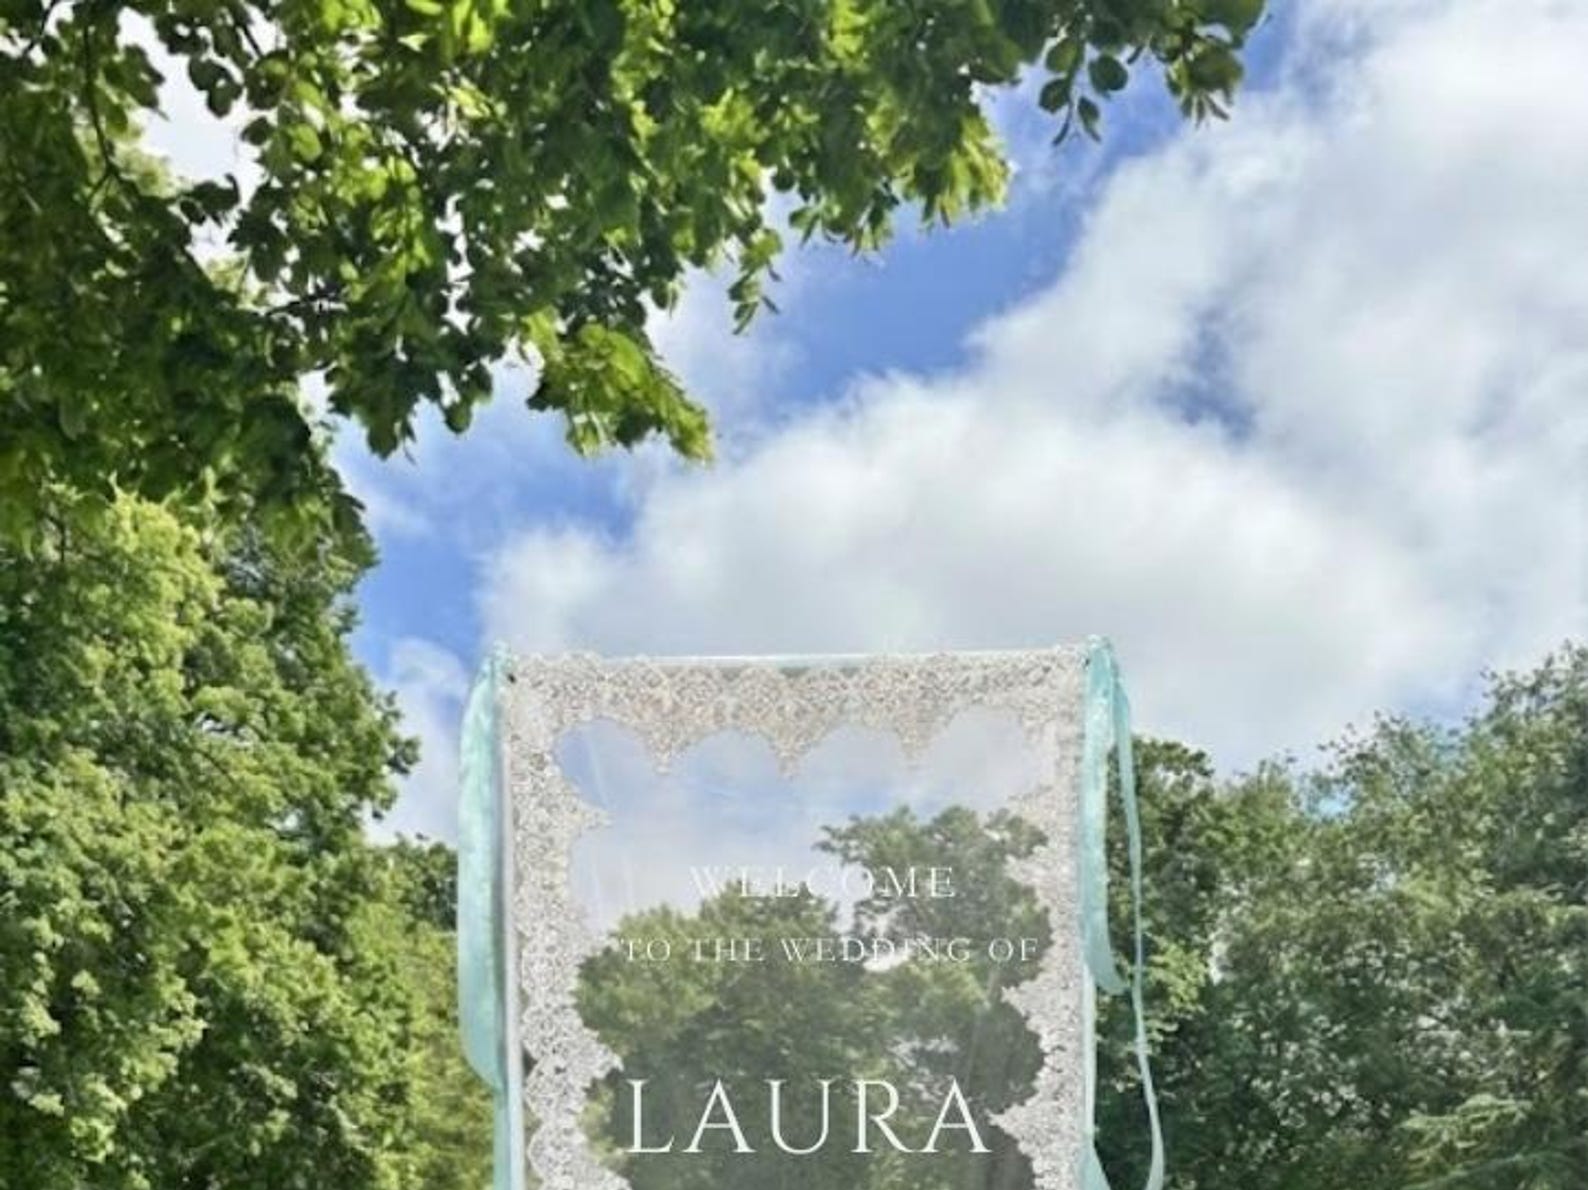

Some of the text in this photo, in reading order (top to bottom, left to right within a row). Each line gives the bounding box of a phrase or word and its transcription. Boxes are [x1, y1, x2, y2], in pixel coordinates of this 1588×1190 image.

[689, 865, 957, 899] WELCOME
[621, 937, 1038, 963] TO THE WEDDING OF
[626, 1078, 993, 1155] LAURA
